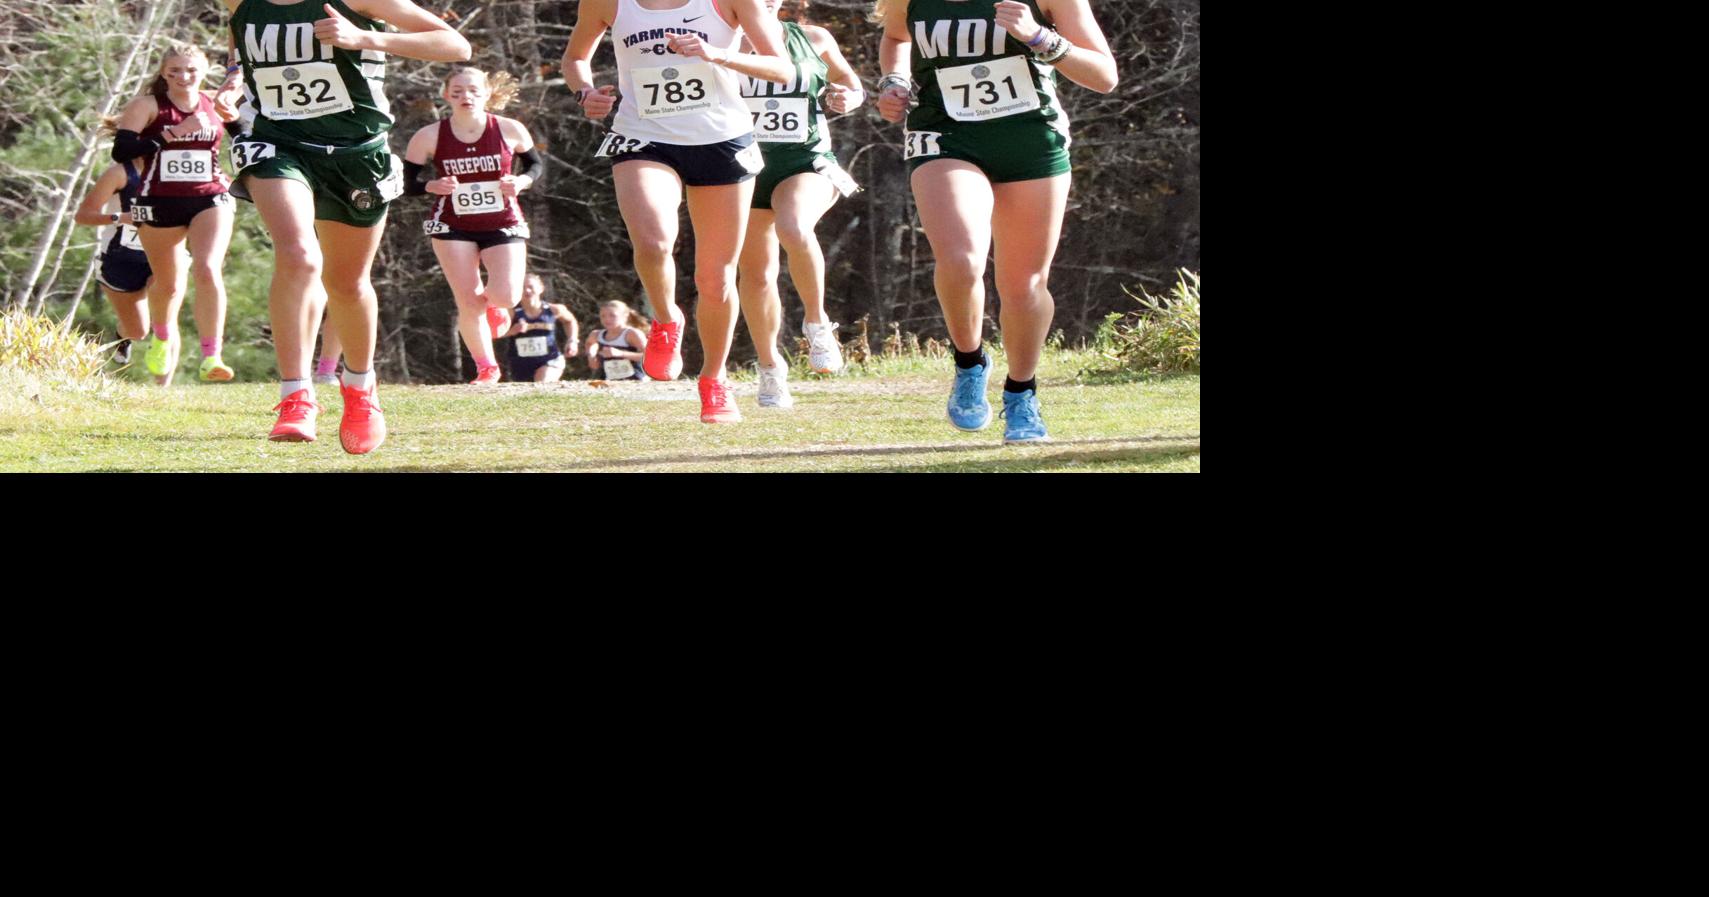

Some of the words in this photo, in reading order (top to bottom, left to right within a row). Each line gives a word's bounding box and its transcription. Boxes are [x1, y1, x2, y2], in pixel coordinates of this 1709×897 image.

[914, 18, 1007, 59] MDI
[265, 78, 336, 108] 732
[643, 79, 705, 106] 783
[951, 75, 1018, 109] 731
[976, 108, 990, 116] State
[167, 160, 205, 174] 698
[442, 154, 502, 176] FREEPORT
[458, 191, 496, 207] 695
